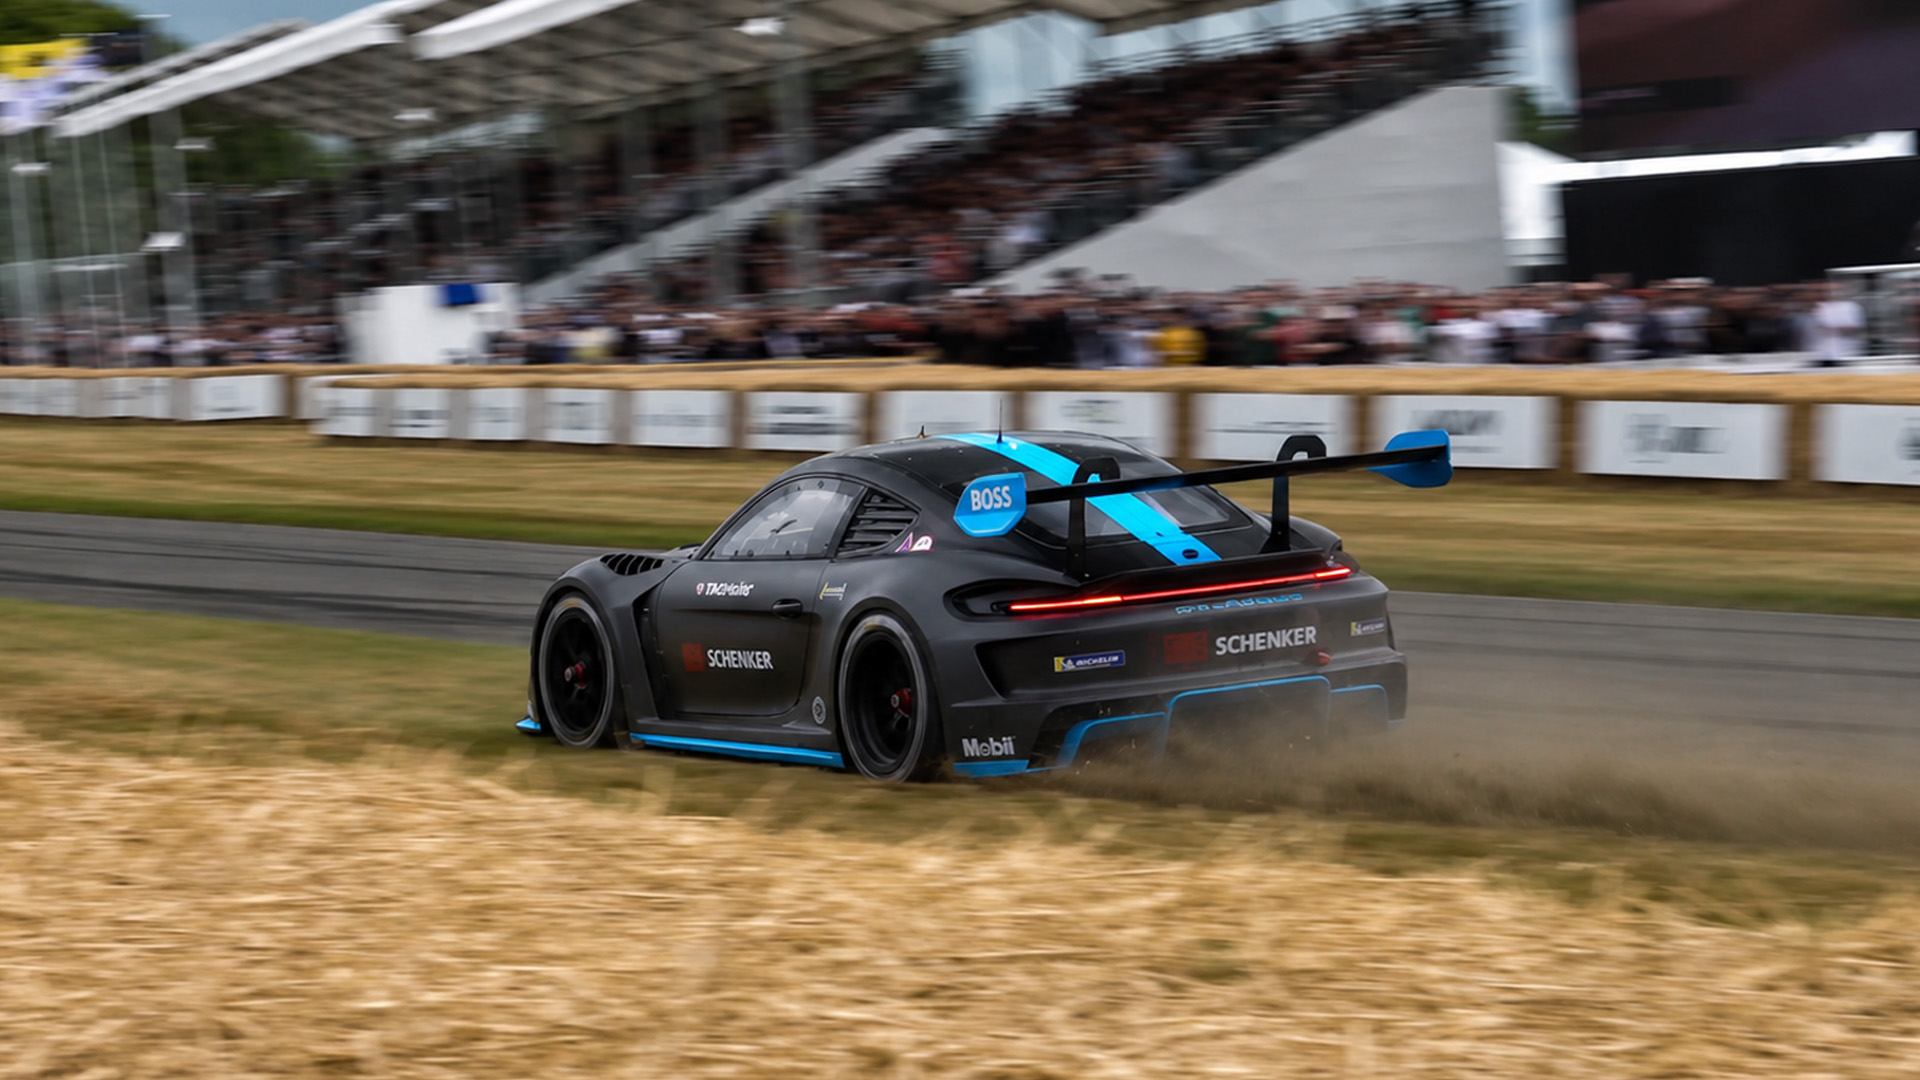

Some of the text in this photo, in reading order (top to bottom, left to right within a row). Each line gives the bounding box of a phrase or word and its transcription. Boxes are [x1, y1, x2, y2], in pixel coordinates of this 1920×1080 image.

[970, 486, 1012, 511] BOSS
[1214, 627, 1317, 656] SCHENKER
[707, 649, 773, 669] SCHENKER
